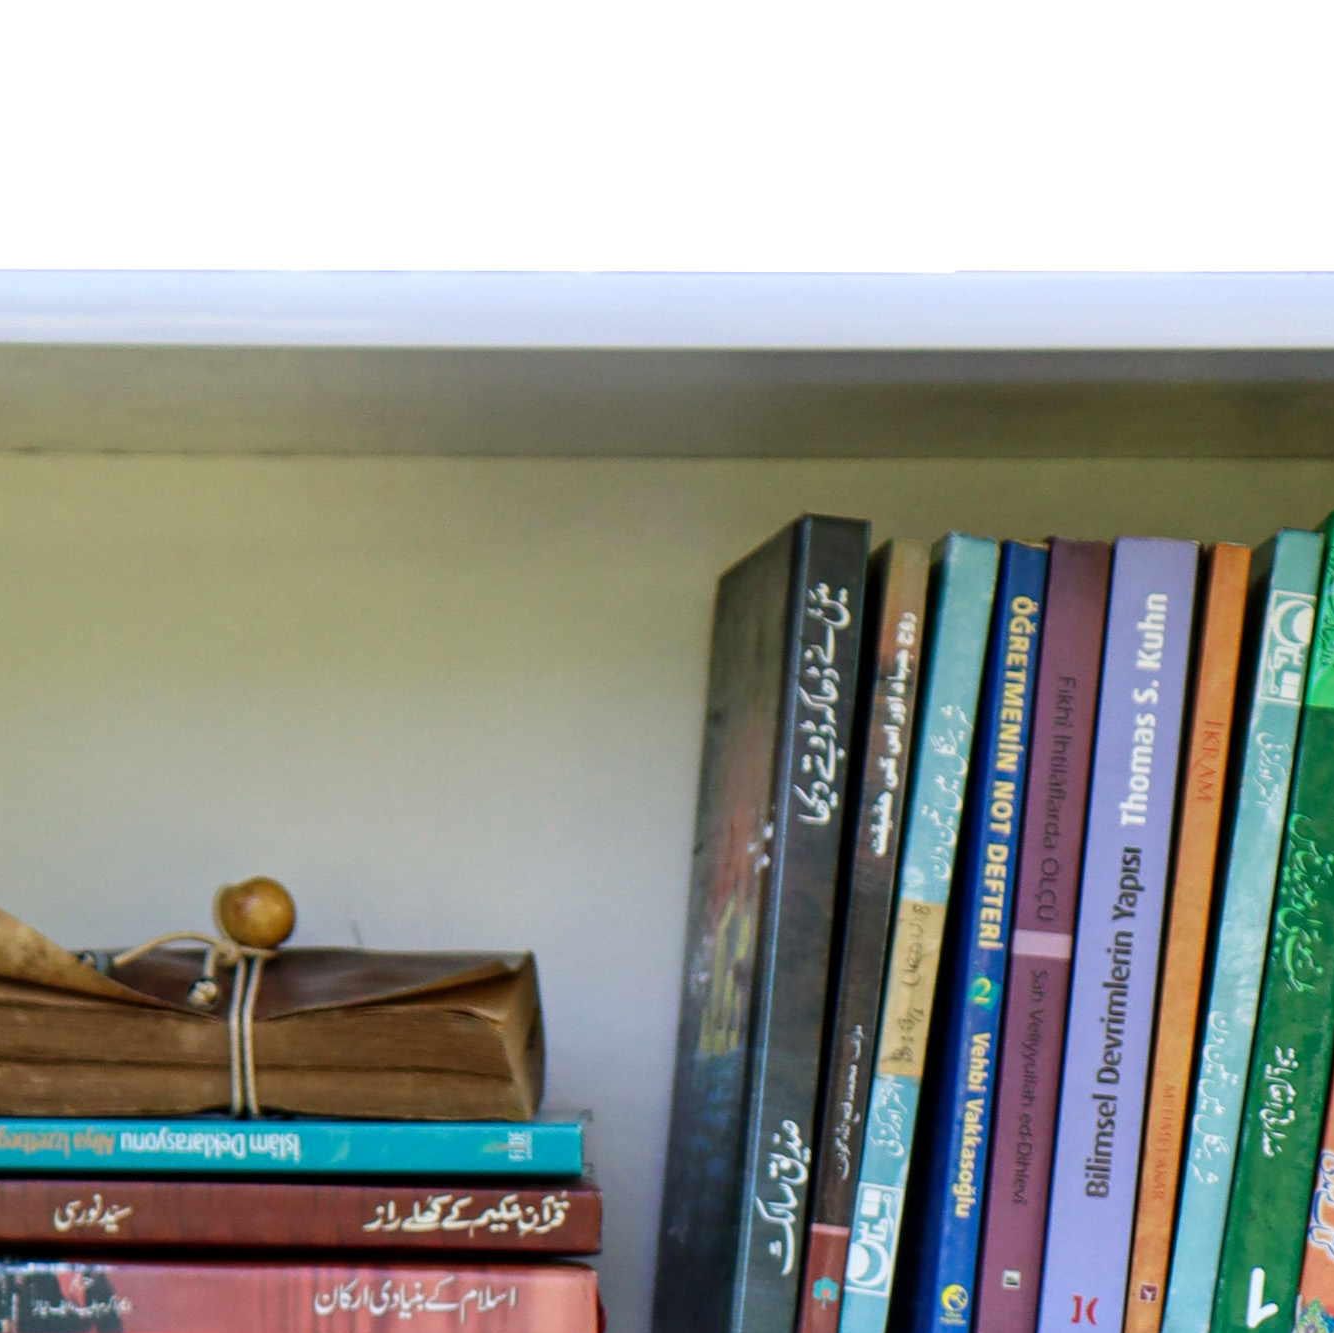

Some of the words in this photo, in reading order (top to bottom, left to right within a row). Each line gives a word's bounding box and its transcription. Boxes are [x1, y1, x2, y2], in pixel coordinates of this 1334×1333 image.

[804, 621, 836, 665] نے
[1136, 593, 1168, 668] Kuhn
[796, 666, 840, 723] ڈھاکہ
[887, 648, 914, 695] جہاد
[996, 596, 1037, 772] ÖĞRETMENİN
[1132, 679, 1159, 704] S.
[886, 695, 907, 724] اور
[800, 720, 846, 783] ڈوبتے
[883, 724, 903, 755] اس
[878, 756, 899, 789] کی
[1120, 713, 1155, 825] Thomas
[794, 779, 839, 825] دیکھا
[871, 791, 893, 857] حقیقت
[990, 781, 1014, 833] NOT
[978, 843, 1009, 949] DEFTERİ
[1034, 857, 1061, 923] ÖLÇÜ
[1111, 846, 1145, 921] Yapısı
[974, 976, 996, 1004] 2
[1096, 930, 1133, 1084] Devrimlerin
[967, 1032, 991, 1091] Vehbi
[1021, 1009, 1045, 1108] Veliyyullah
[1264, 1045, 1299, 1077] یافتہ
[121, 1128, 246, 1158] Deklarasyonu
[249, 1133, 299, 1161] İslâm
[952, 1098, 984, 1218] Vakkasoğlu
[1085, 1093, 1117, 1198] Bilimsel
[362, 1200, 400, 1231] راز
[402, 1195, 452, 1231] کھلے
[441, 1196, 473, 1229] کے
[744, 1182, 799, 1275] سالک
[313, 1281, 371, 1315] ارکان
[369, 1281, 428, 1320] بنیادی
[425, 1278, 458, 1311] کے
[457, 1286, 516, 1322] اسلام
[1245, 1267, 1278, 1329] 1
